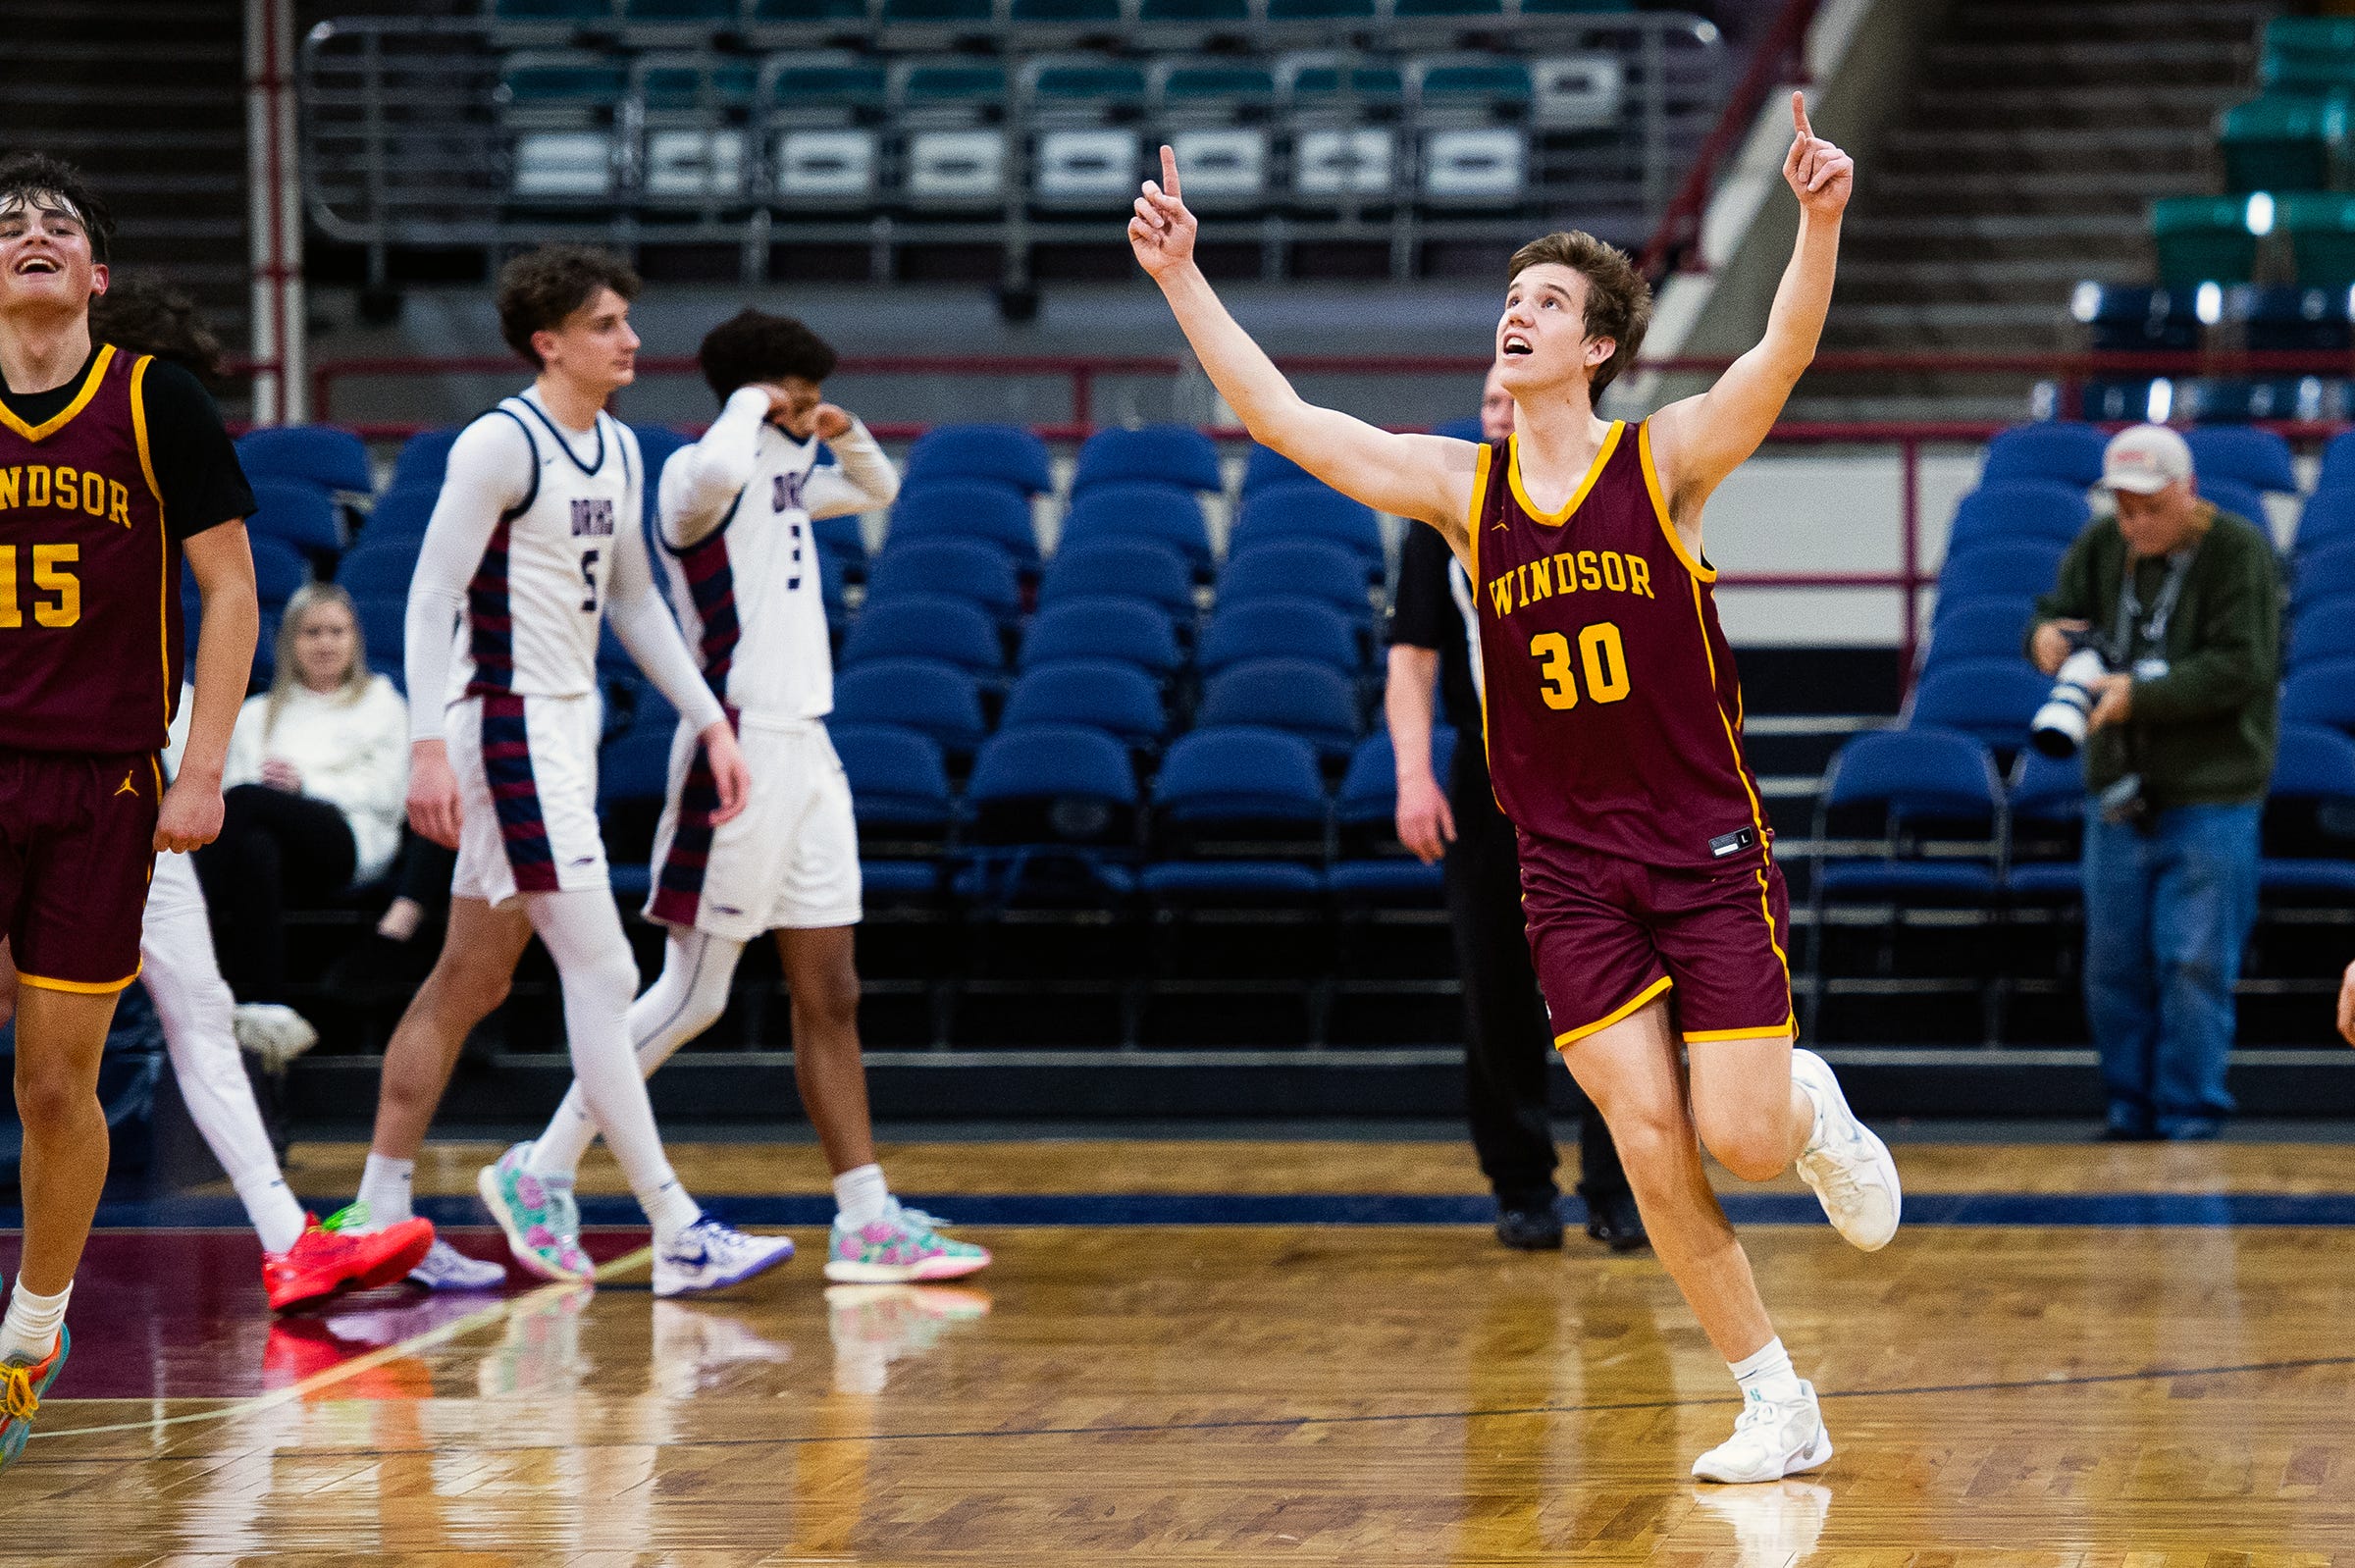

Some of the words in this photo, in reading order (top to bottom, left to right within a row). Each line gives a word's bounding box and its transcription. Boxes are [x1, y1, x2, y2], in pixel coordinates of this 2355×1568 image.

[0, 465, 131, 529] NDSOR
[0, 545, 80, 627] 15
[1489, 550, 1654, 619] WINDSOR
[1530, 622, 1631, 710] 30
[1741, 834, 1749, 844] L
